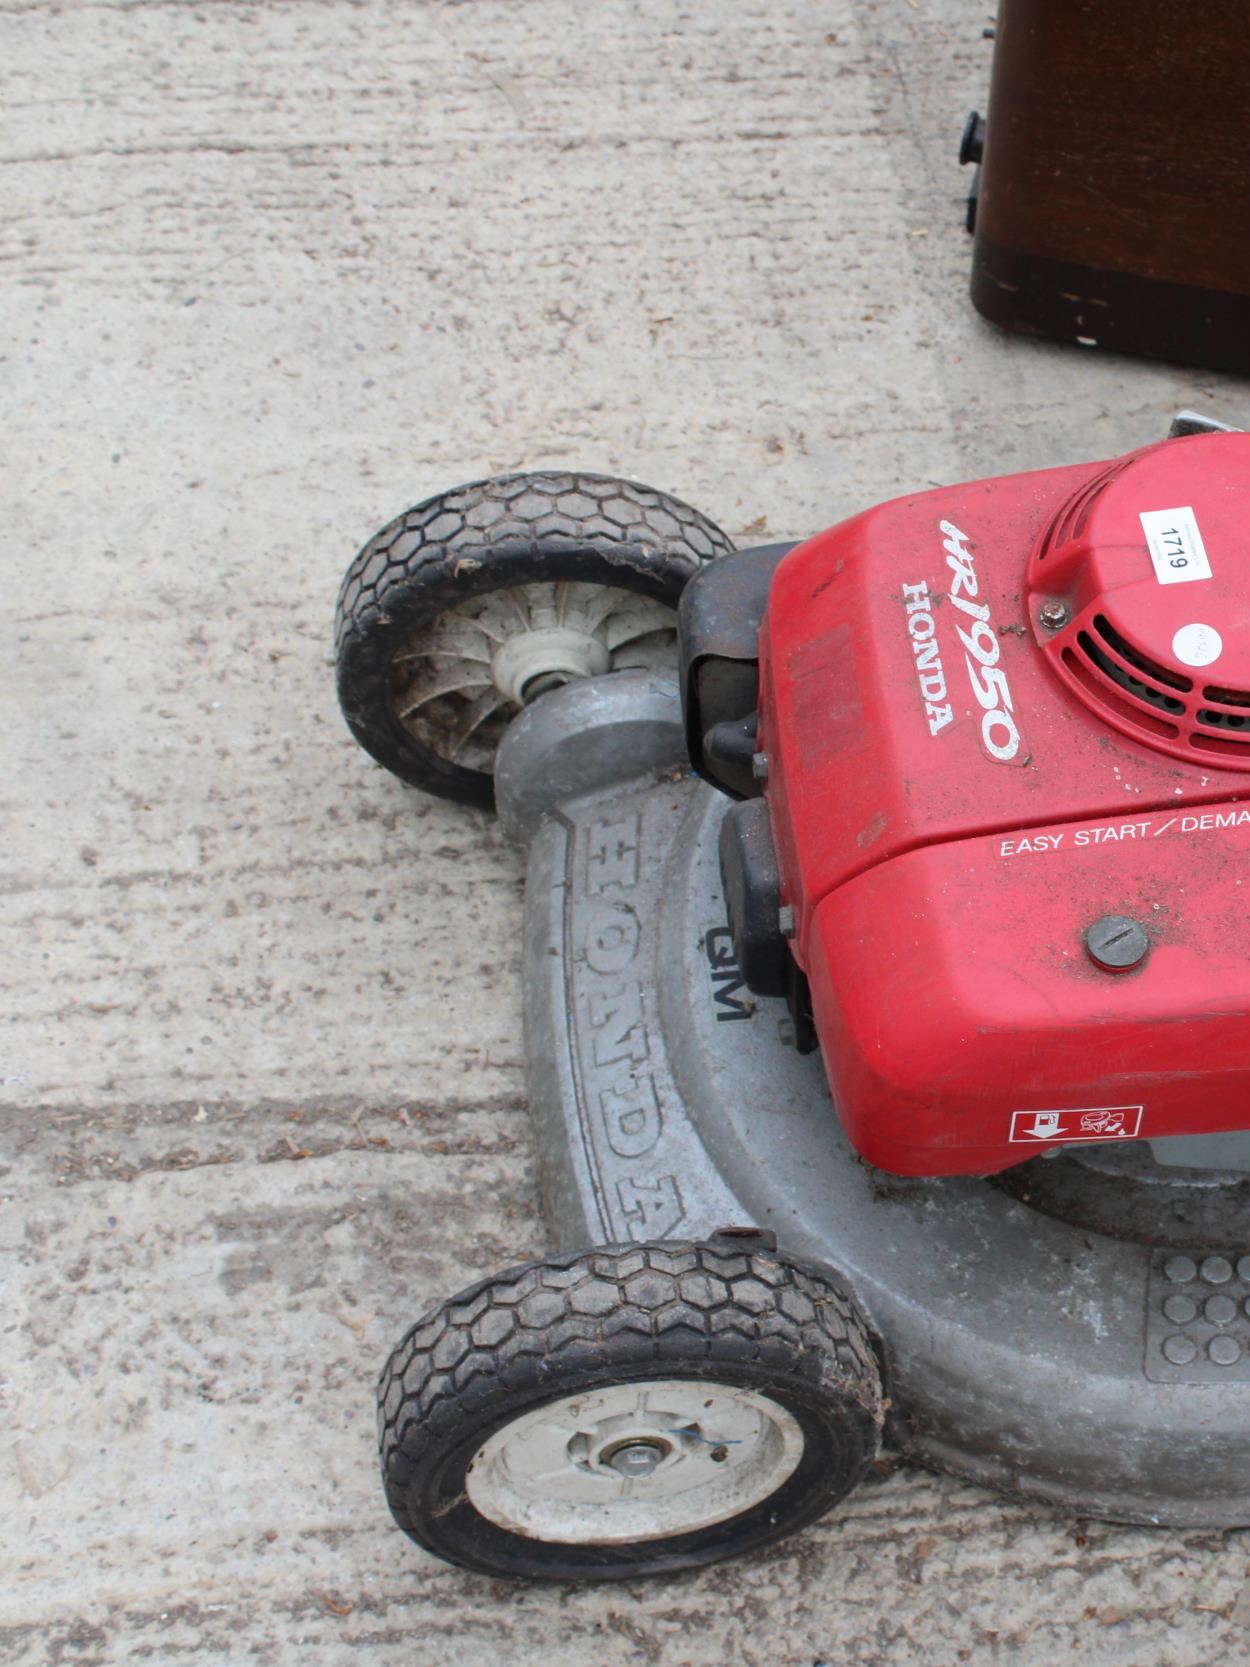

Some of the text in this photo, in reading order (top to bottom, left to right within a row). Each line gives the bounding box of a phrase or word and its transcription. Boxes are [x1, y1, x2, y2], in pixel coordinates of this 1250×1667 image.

[1160, 527, 1188, 569] 1719
[903, 580, 954, 736] HONDA
[999, 833, 1064, 857] EASY
[583, 812, 686, 1244] HONDA
